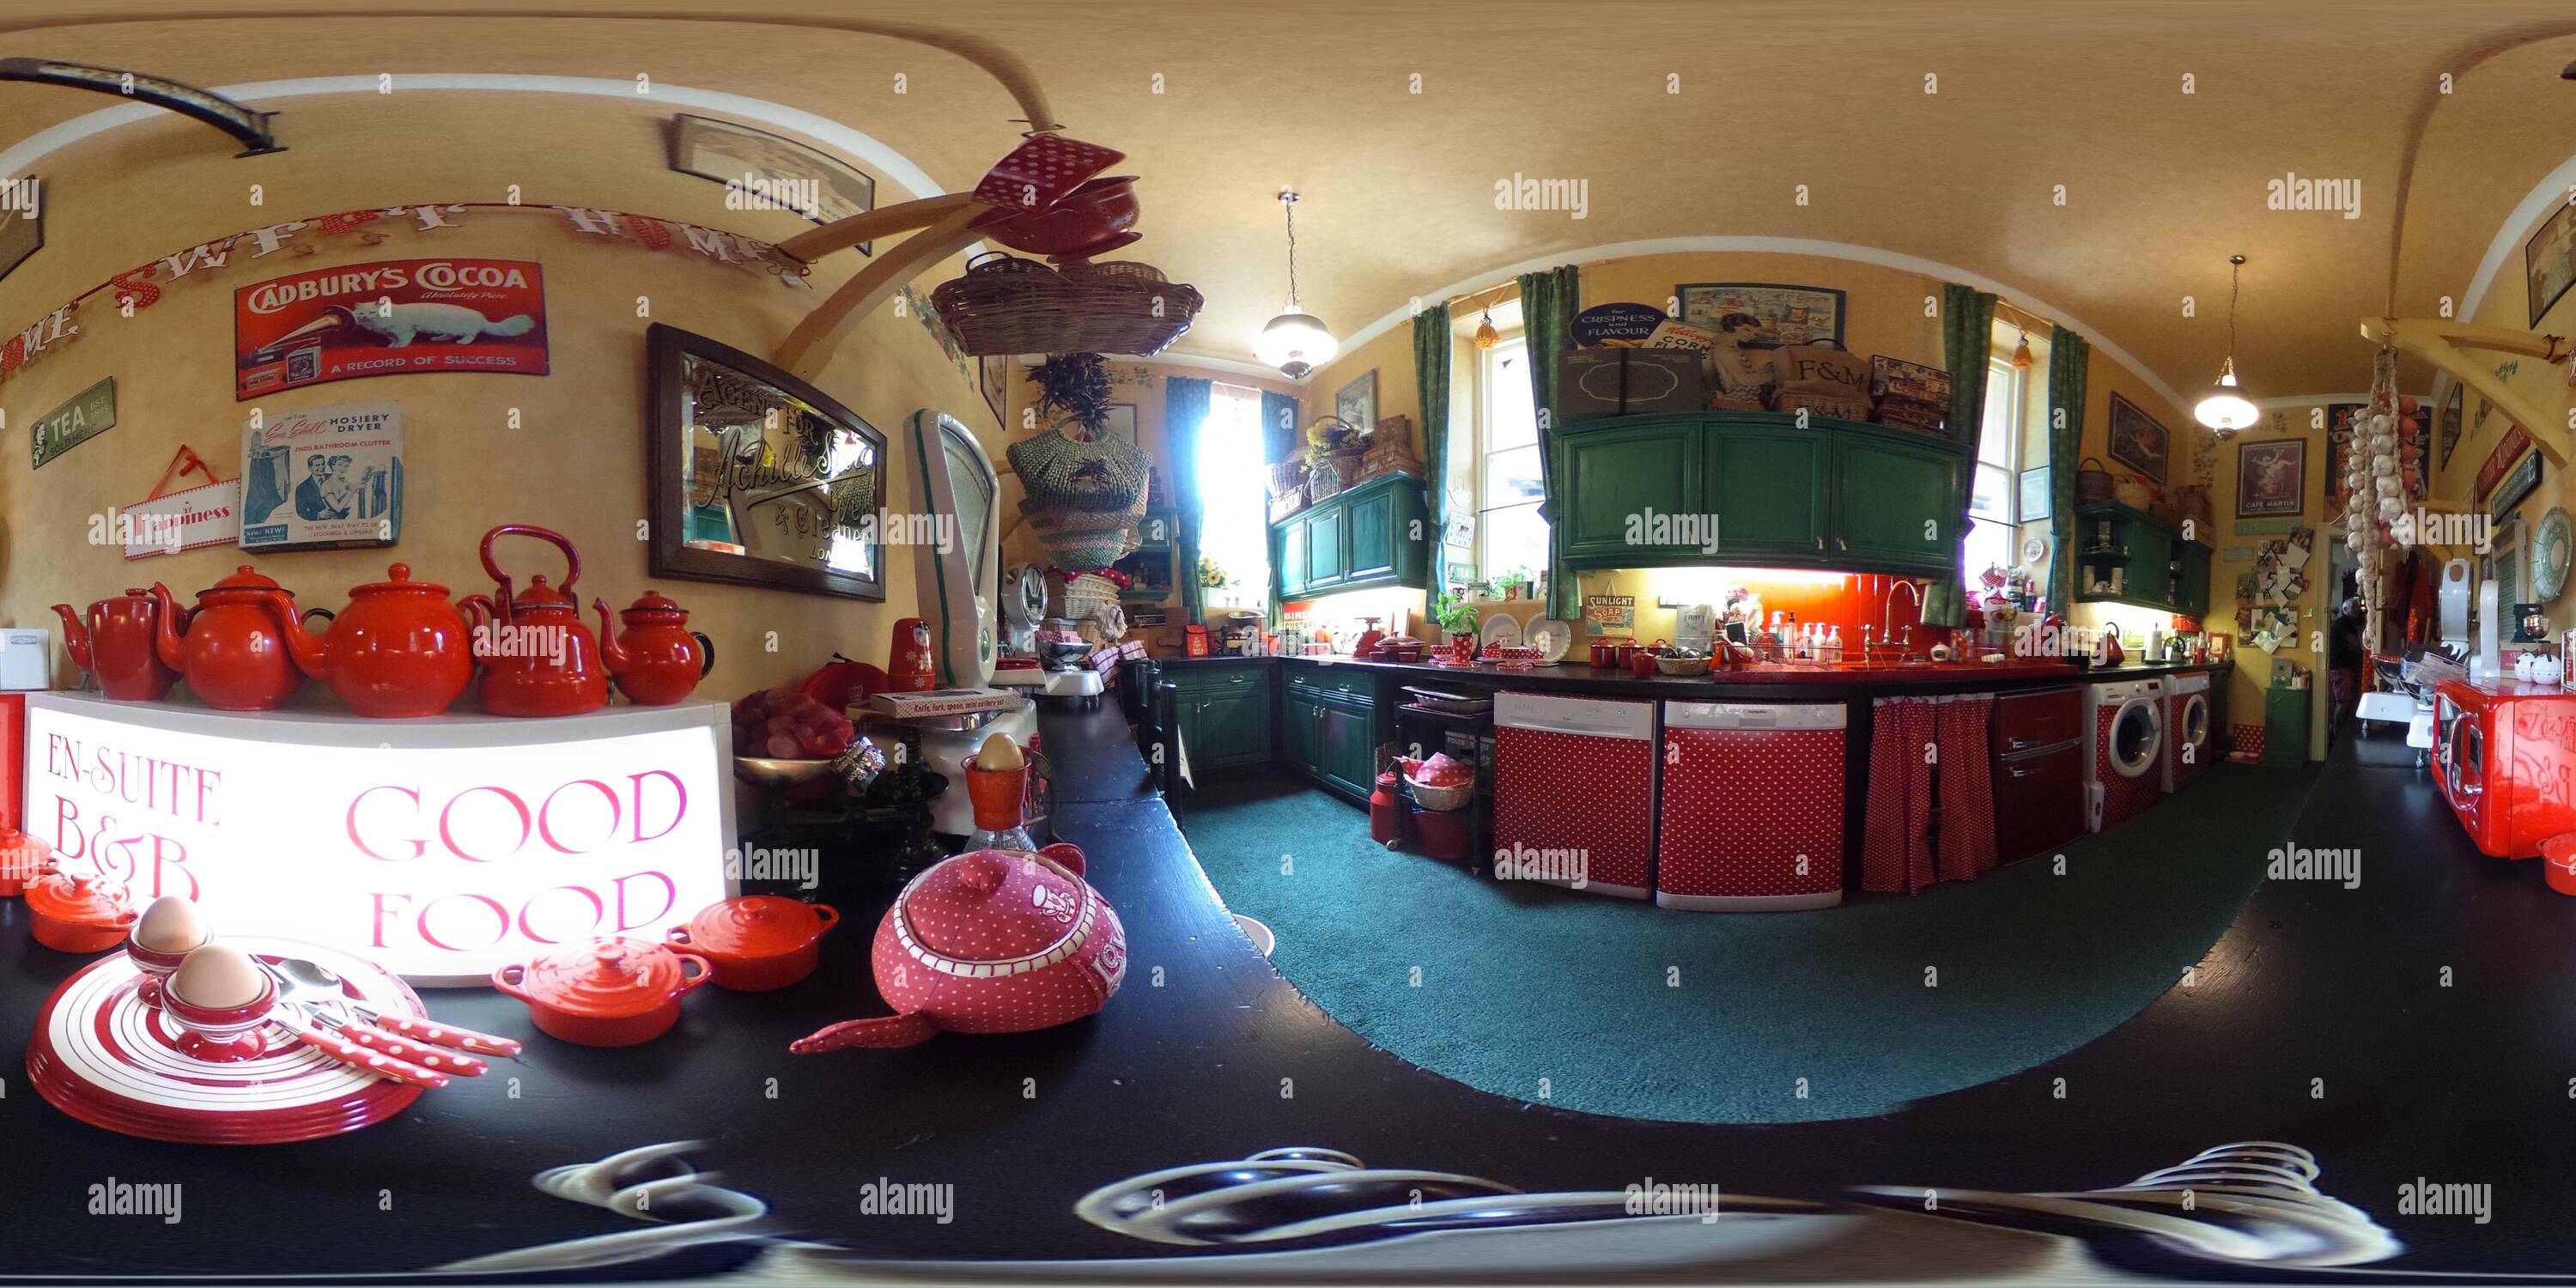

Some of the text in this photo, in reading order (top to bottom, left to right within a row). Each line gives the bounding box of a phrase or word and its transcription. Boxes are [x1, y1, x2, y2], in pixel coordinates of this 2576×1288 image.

[248, 262, 528, 314] CADBURY'S COCOA
[1581, 314, 1656, 324] CRISPNESS
[1588, 327, 1649, 337] FLAVOUR
[1662, 336, 1711, 353] CORN
[331, 355, 517, 374] A RECORD OF SUCCESS
[1797, 360, 1864, 386] F&M
[51, 405, 86, 442] TEA
[330, 414, 389, 425] HOSIERY
[337, 423, 381, 433] DRYER
[50, 426, 97, 457] SOLD HERE
[313, 441, 358, 451] BATHROOM
[1456, 568, 1470, 578] TEA
[1589, 596, 1633, 609] SUNLIGHT
[1594, 608, 1620, 619] SOAP
[914, 703, 931, 713] Knife,
[932, 702, 945, 712] fork,
[947, 703, 964, 712] spoon,
[965, 701, 977, 709] mini
[978, 700, 996, 708] cutlery
[47, 732, 222, 827] EN-SUITE
[345, 769, 688, 863] GOOD
[53, 794, 200, 903] B&B
[368, 870, 676, 951] FOOD
